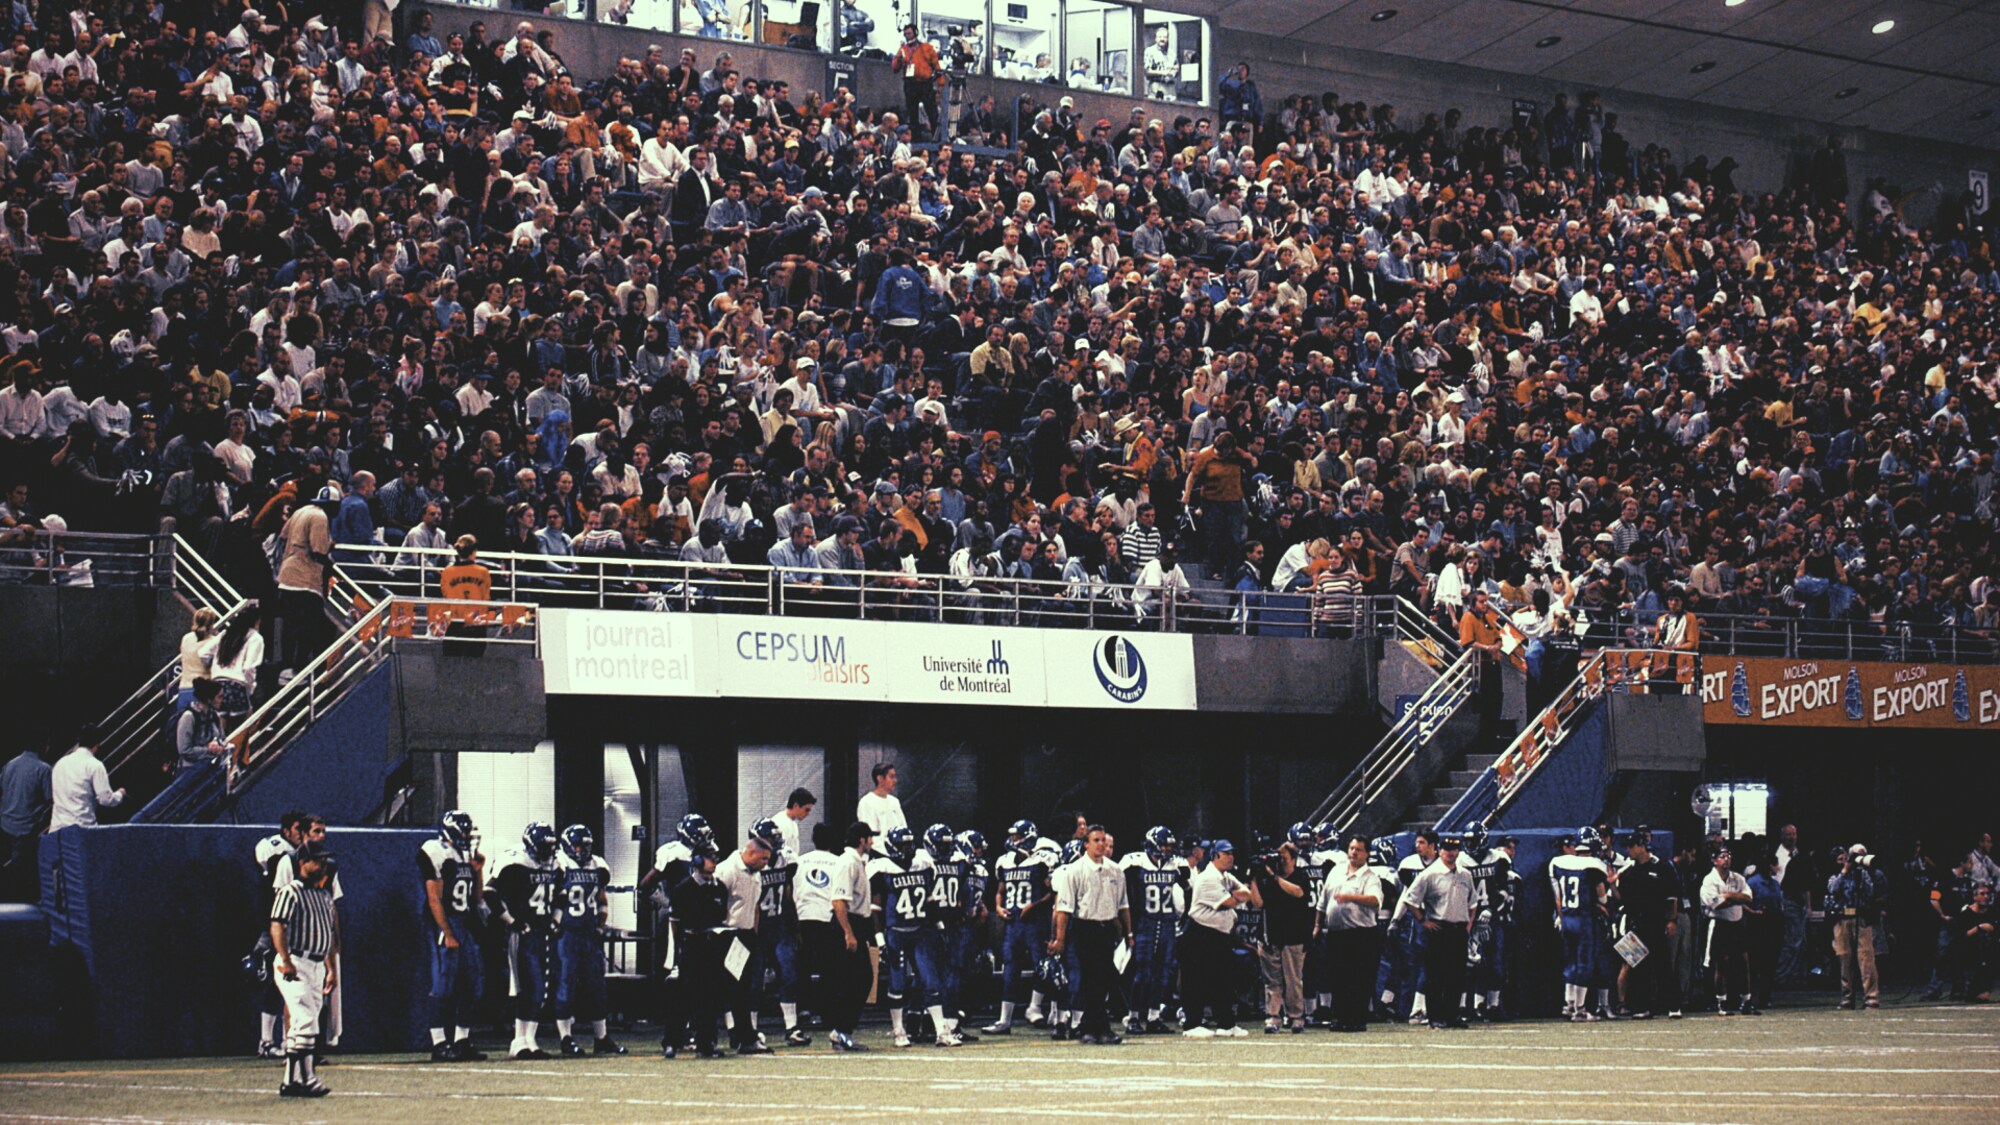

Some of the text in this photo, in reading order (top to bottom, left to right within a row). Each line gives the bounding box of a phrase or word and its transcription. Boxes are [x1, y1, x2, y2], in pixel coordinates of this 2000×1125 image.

[828, 61, 855, 71] SECTION
[1973, 180, 1984, 210] 9
[586, 618, 672, 651] journal
[736, 631, 846, 664] CEPSUM
[575, 653, 688, 680] montreal
[923, 655, 982, 673] Université
[1783, 662, 1818, 680] MOLSON
[1894, 666, 1927, 683] MOLSON
[940, 676, 1011, 693] de Montréal
[1107, 684, 1143, 701] CARABINS
[1761, 675, 1841, 719] EXPORT
[1873, 678, 1949, 721] EXPORT
[893, 874, 925, 888] CARABINS
[932, 877, 959, 907] 40
[1559, 875, 1580, 908] 13
[568, 884, 599, 917] 94
[760, 884, 784, 916] 41
[895, 887, 926, 919] 42
[1145, 884, 1174, 913] 82
